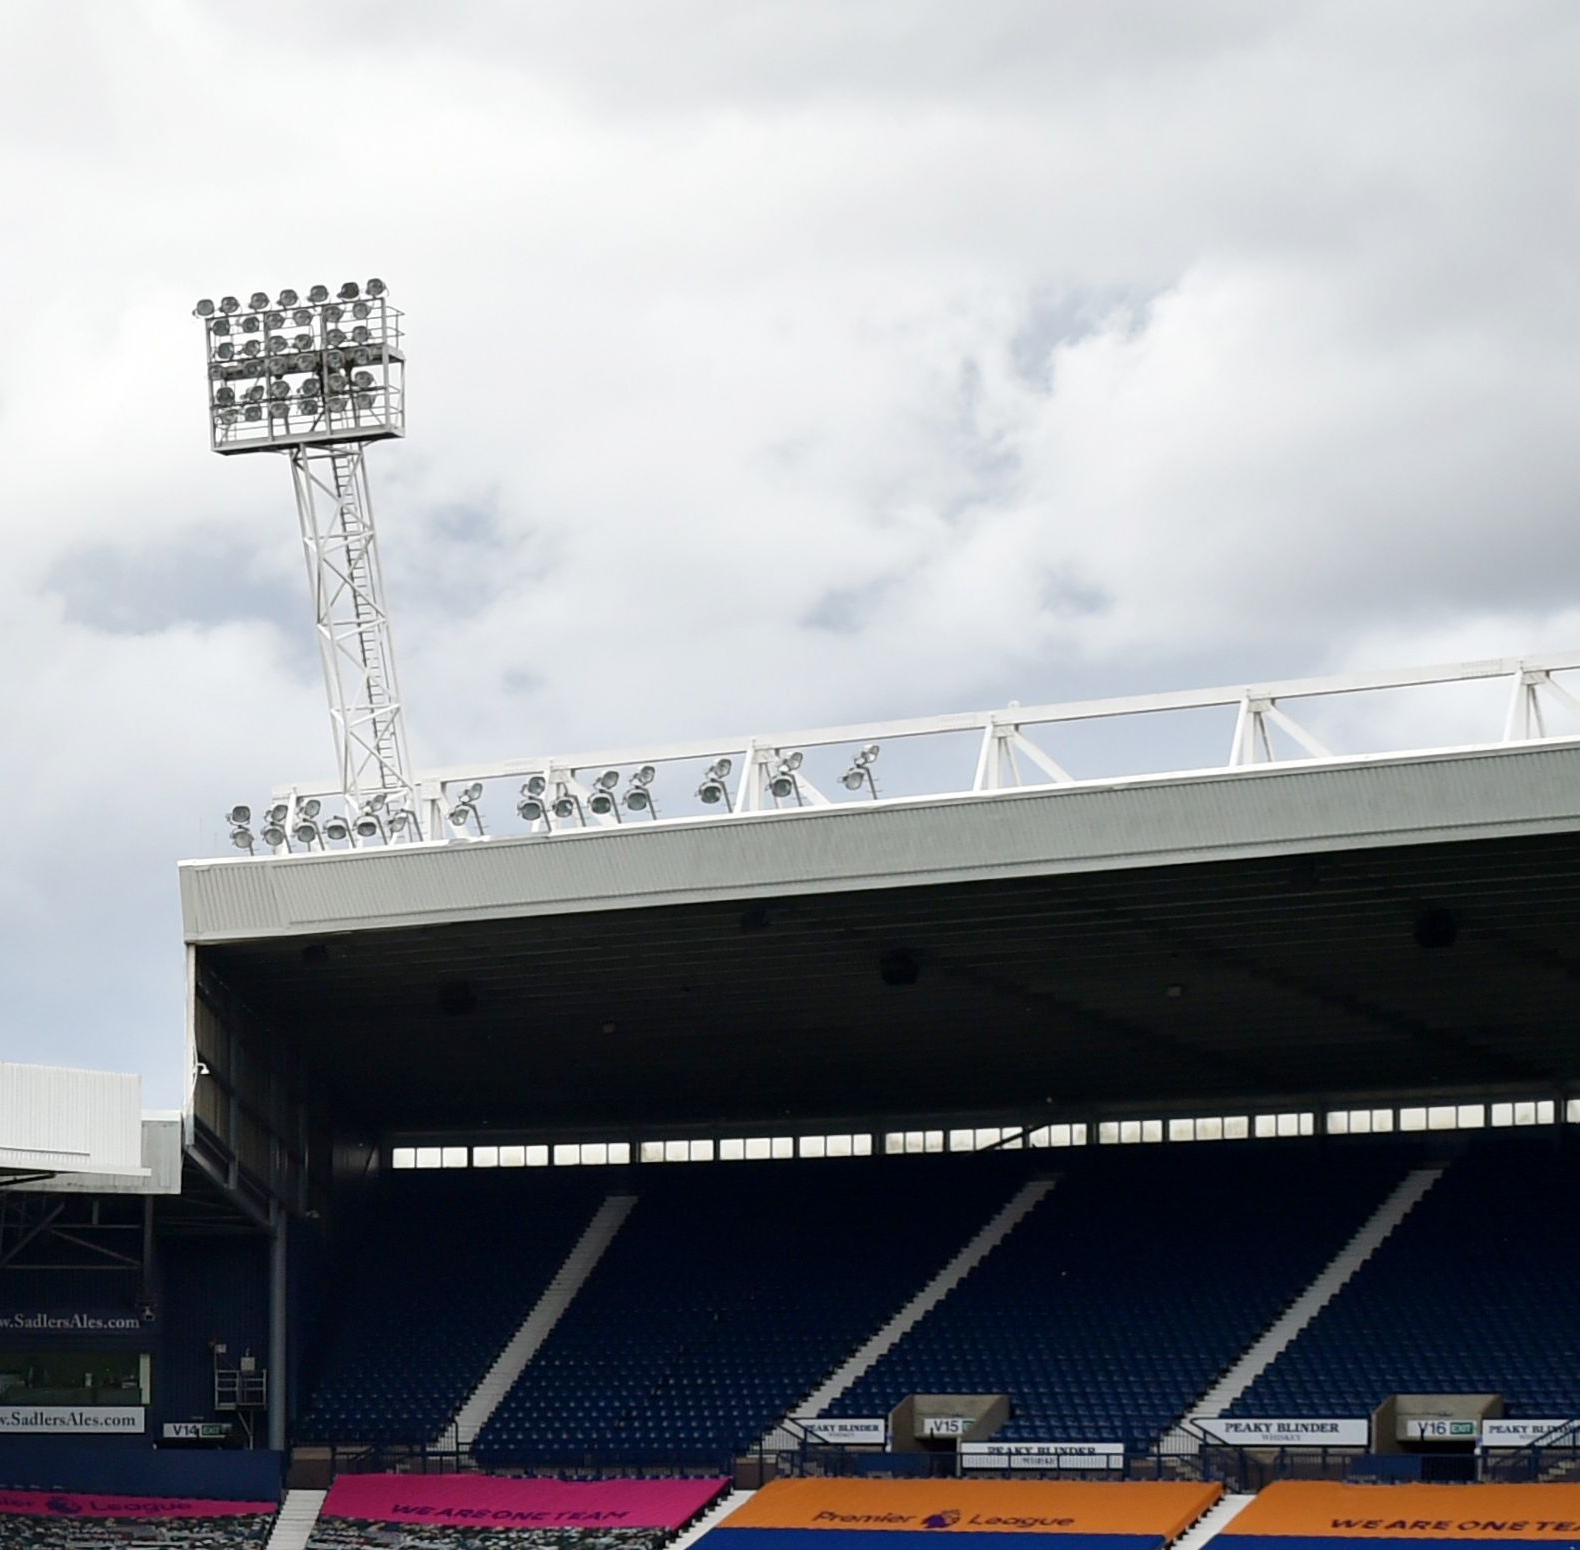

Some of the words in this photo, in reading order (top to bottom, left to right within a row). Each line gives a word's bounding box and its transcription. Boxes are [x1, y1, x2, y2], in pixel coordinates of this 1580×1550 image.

[838, 1424, 880, 1433] BLINDER
[934, 1420, 959, 1433] V15
[1224, 1422, 1274, 1434] PEAKY
[1276, 1423, 1340, 1434] BLINDER
[1418, 1421, 1447, 1435] V16
[1451, 1423, 1473, 1434] EXIT
[1489, 1424, 1529, 1434] PEAKY
[91, 1499, 193, 1514] League
[391, 1504, 437, 1515] WE
[492, 1510, 553, 1521] ONE
[553, 1511, 632, 1522] TEAM
[811, 1511, 917, 1525] Premier
[968, 1514, 1075, 1529] League
[1330, 1518, 1387, 1530] WE
[1385, 1519, 1453, 1531] ARE
[1455, 1520, 1532, 1532] ONE
